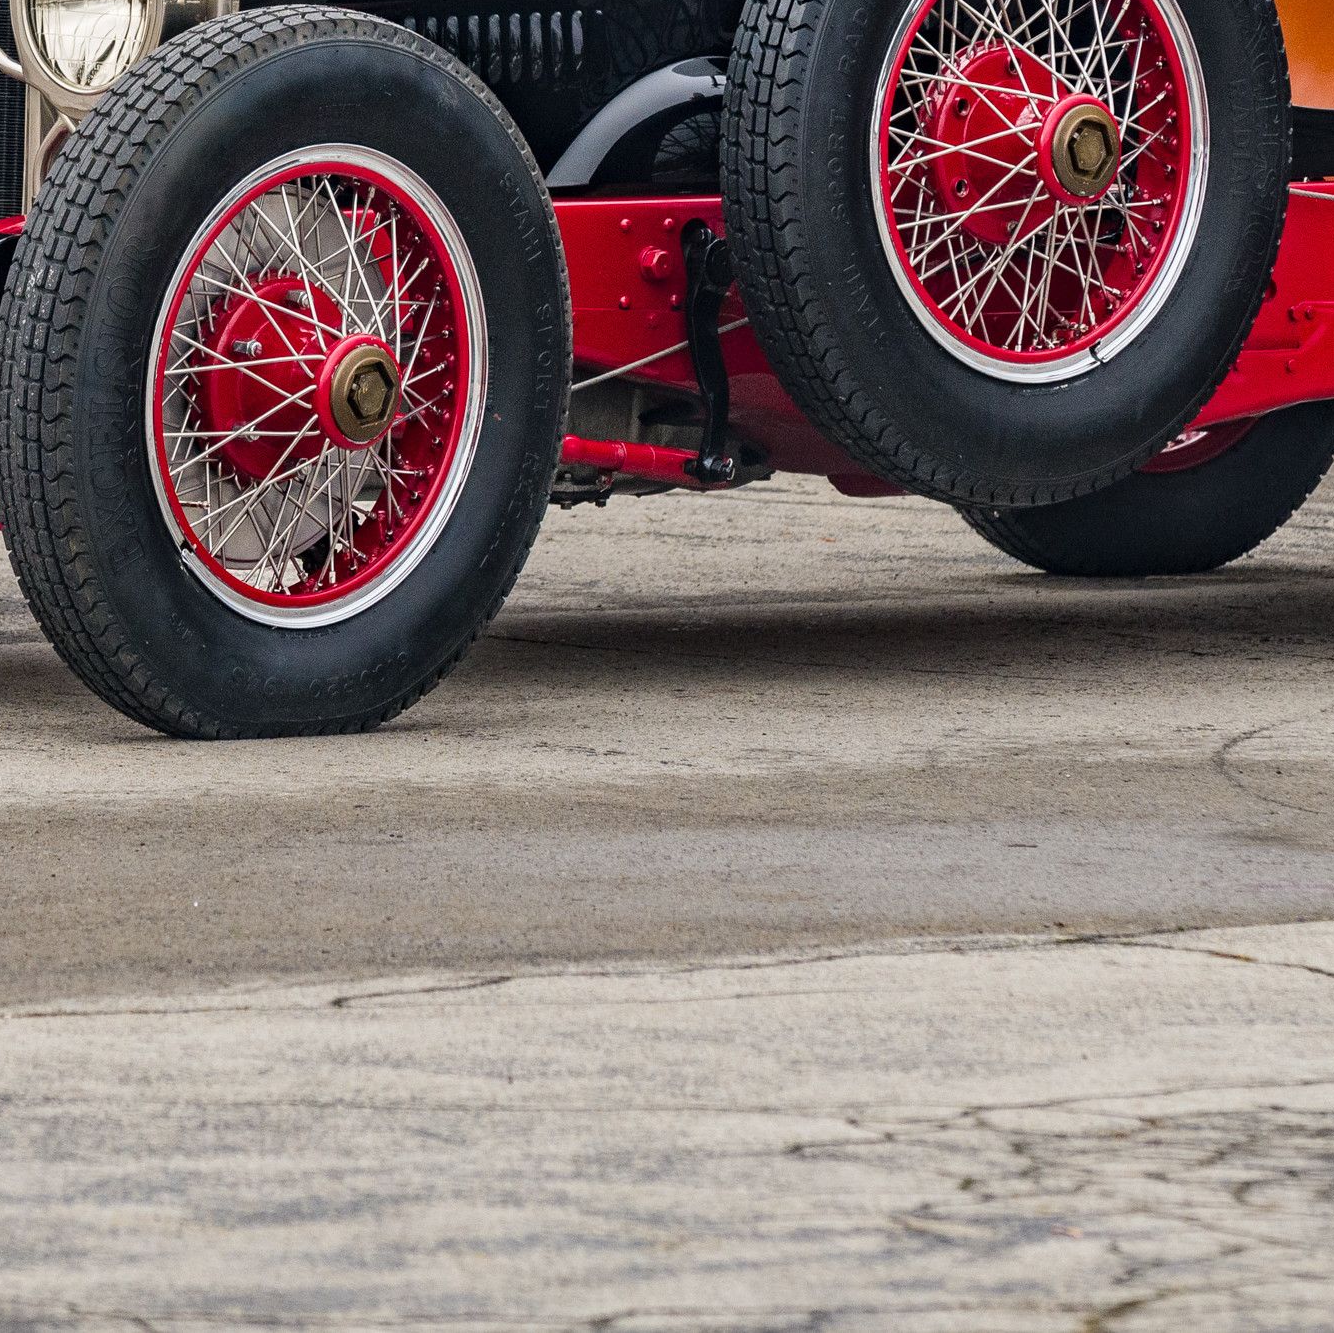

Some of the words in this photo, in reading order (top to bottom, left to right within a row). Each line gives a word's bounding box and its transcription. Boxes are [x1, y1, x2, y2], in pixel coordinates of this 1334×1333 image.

[827, 108, 848, 223] SPORT
[88, 232, 162, 575] EXCELSIOR
[534, 302, 553, 417] SPORT
